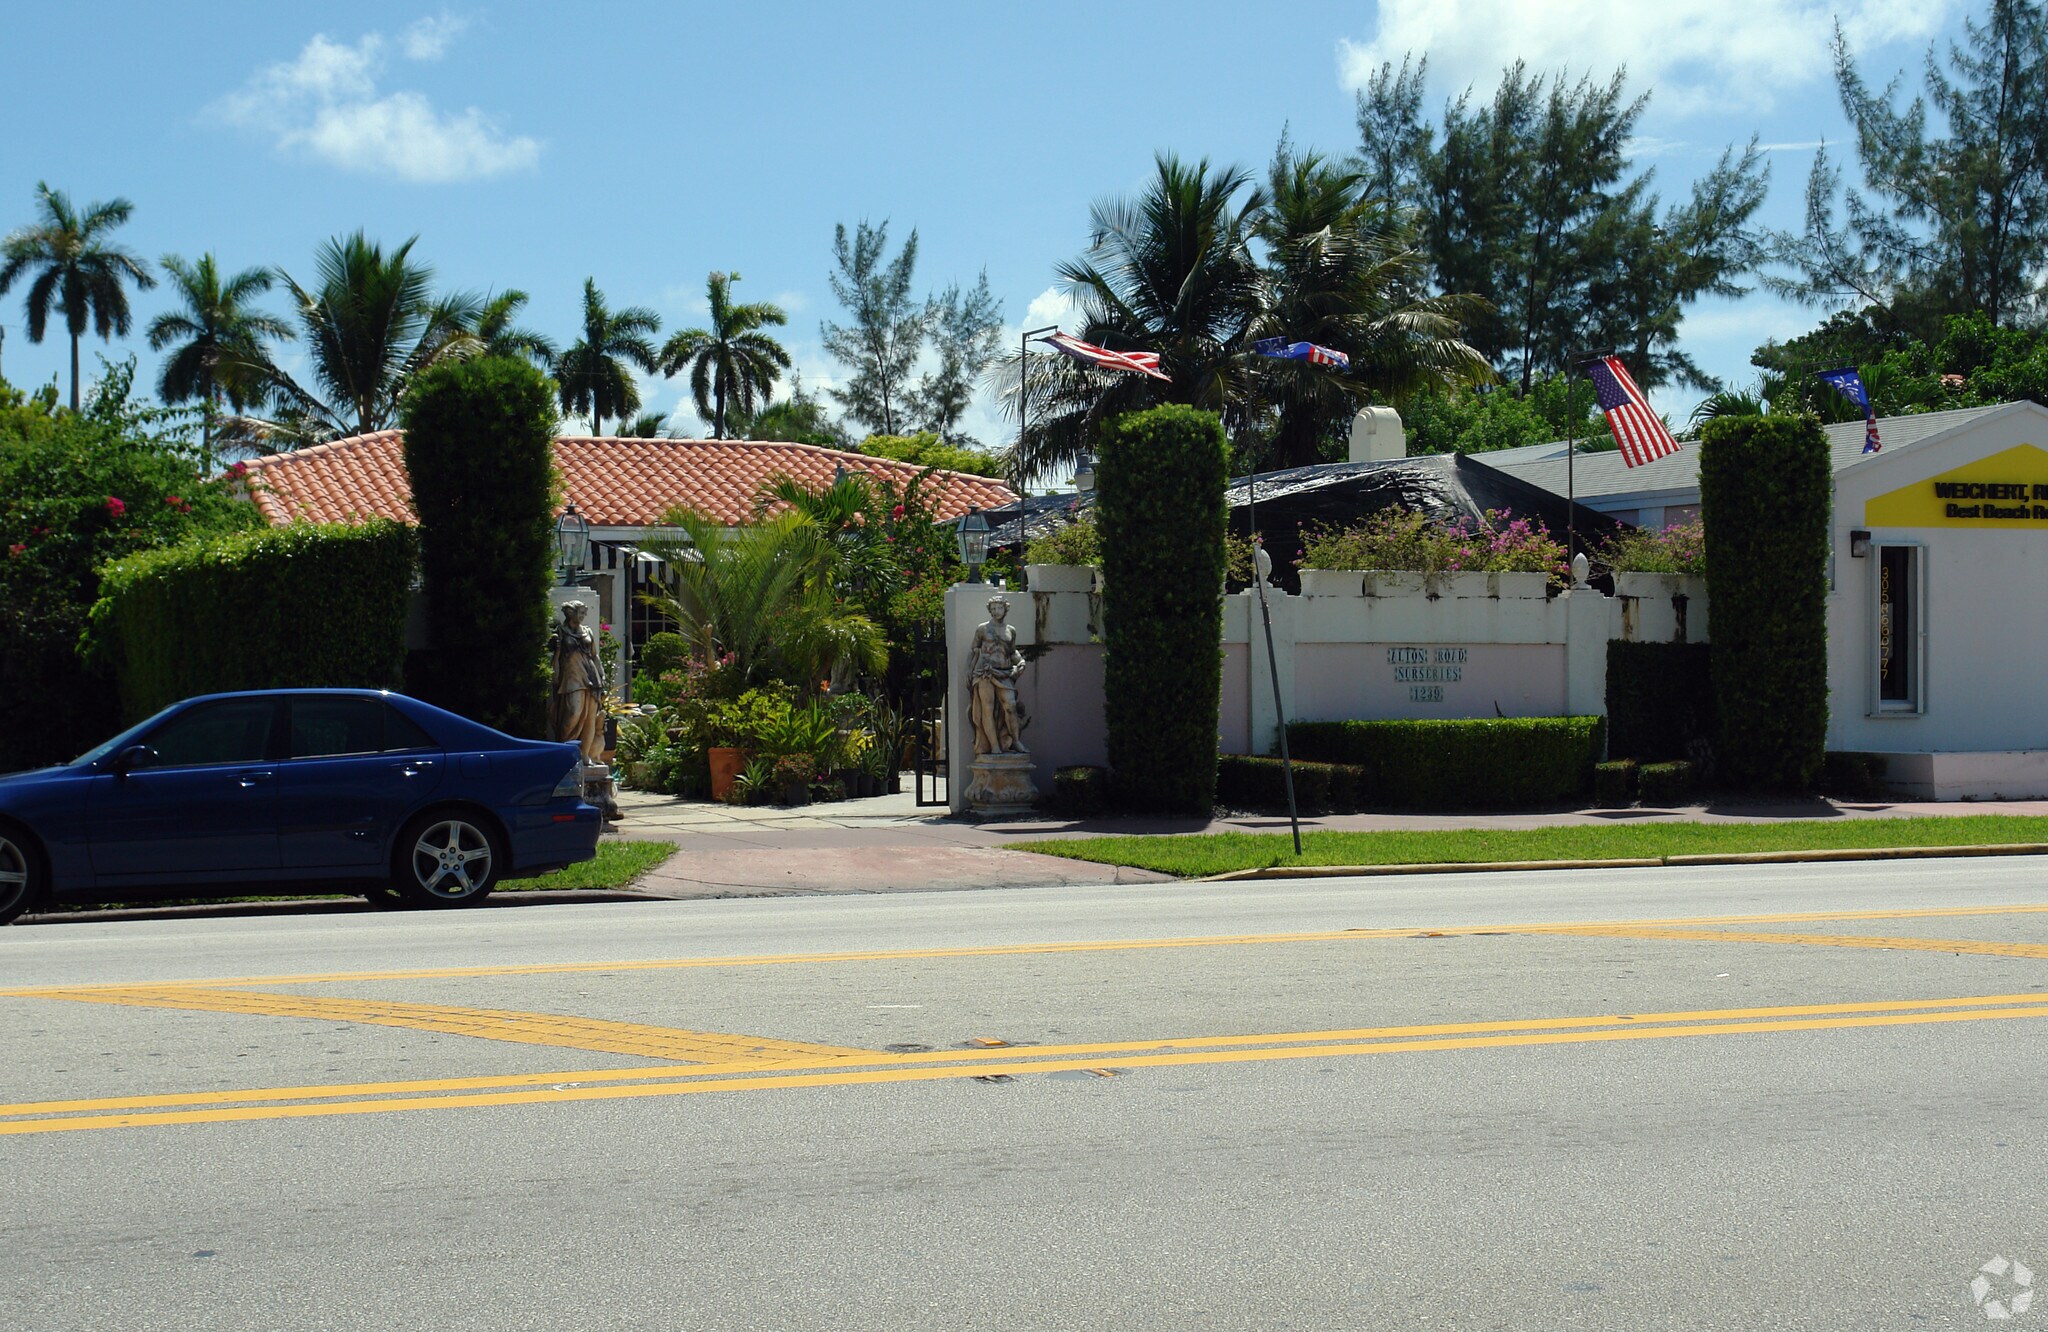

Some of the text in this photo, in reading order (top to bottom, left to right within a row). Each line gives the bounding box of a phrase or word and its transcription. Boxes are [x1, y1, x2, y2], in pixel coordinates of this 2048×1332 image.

[1935, 483, 2029, 502] WEICHERT,
[1946, 504, 1981, 518] Best
[1983, 504, 2030, 519] Beach
[1437, 649, 1465, 662] ROAD
[1397, 667, 1459, 680] NURSERIES
